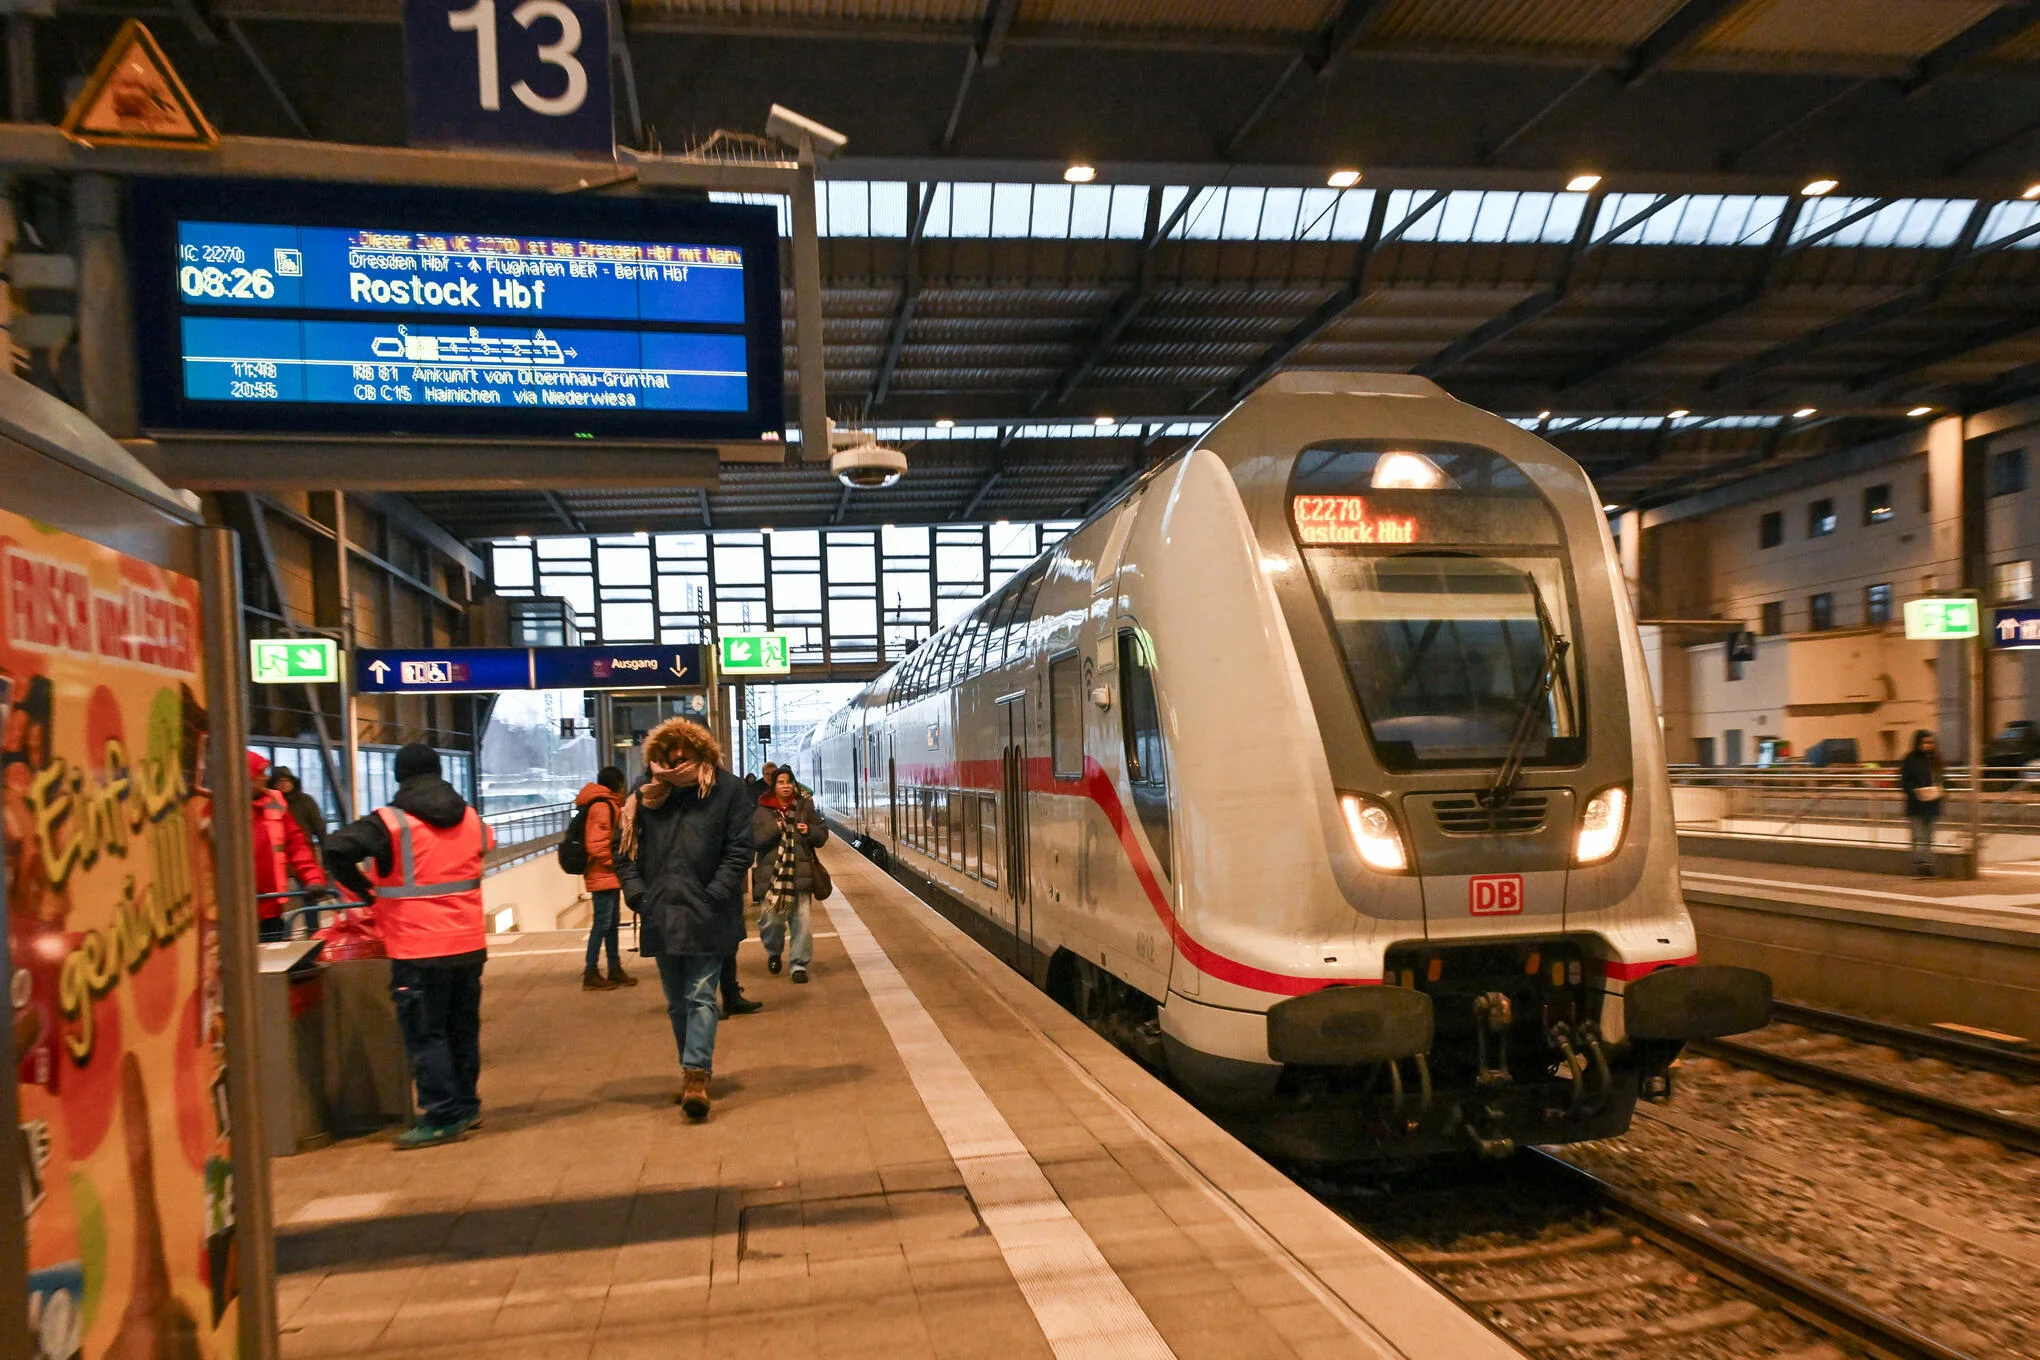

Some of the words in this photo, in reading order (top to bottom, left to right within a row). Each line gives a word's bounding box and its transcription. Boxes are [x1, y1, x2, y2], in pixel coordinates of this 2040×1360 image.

[448, 0, 588, 116] 13
[180, 244, 199, 262] IC
[202, 245, 245, 263] 2270
[349, 251, 417, 270] Dresden
[421, 253, 450, 272] Hbf
[485, 256, 566, 278] Flughafen
[569, 260, 597, 278] BER
[614, 263, 659, 281] Berlin
[663, 265, 689, 282] Hbf
[180, 265, 275, 299] 08:26
[349, 272, 481, 307] Rostock
[492, 278, 546, 310] Hbf
[353, 364, 375, 381] RB
[412, 366, 479, 384] Ankunft
[483, 369, 514, 385] von
[518, 370, 670, 389] Olbernhau-Grünthal
[380, 385, 412, 402] C15
[425, 386, 501, 404] Hainichen
[513, 388, 539, 405] via
[542, 388, 636, 408] Niederwiesa
[1377, 519, 1413, 543] Hbf
[610, 657, 658, 671] Ausgang
[1474, 879, 1520, 912] DB
